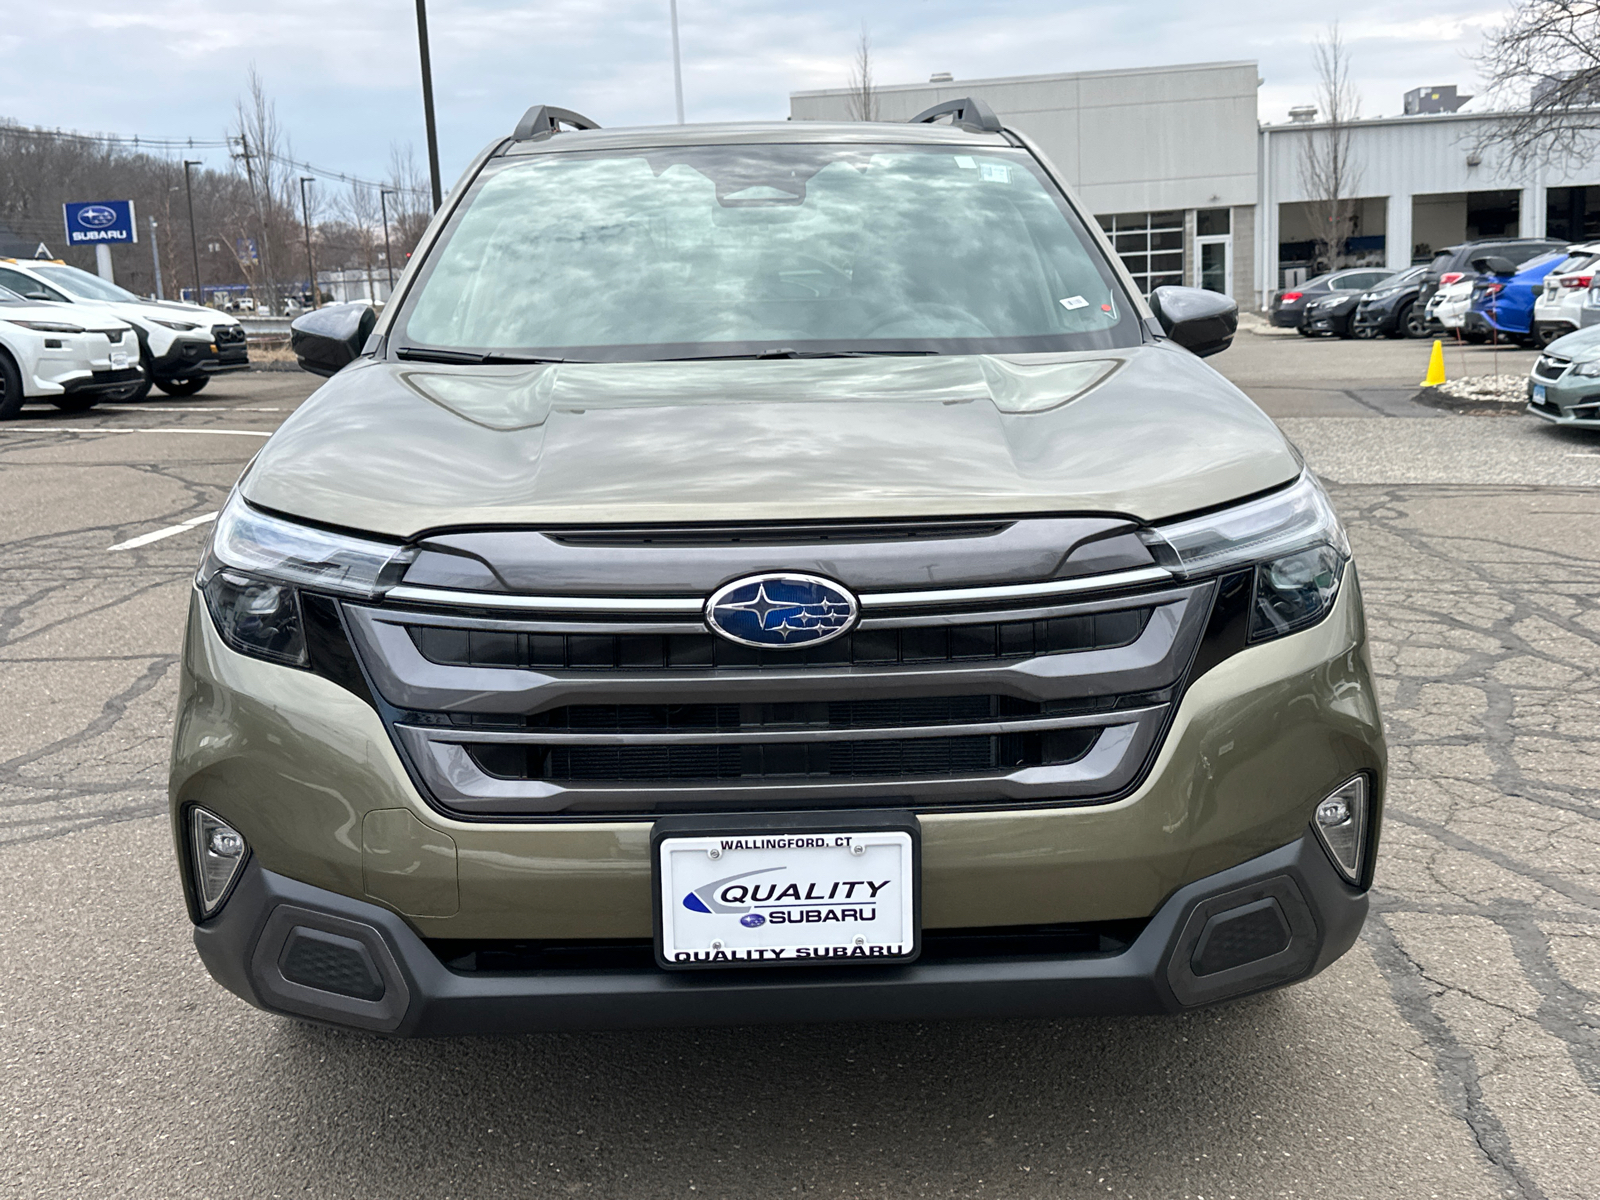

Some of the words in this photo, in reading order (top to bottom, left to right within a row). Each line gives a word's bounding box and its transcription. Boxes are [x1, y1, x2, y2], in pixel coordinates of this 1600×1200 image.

[72, 230, 127, 241] SUBARU
[720, 838, 829, 850] WALLINGFORD,
[835, 837, 852, 847] CT
[720, 880, 891, 904] QUALITY
[768, 908, 876, 924] SUBARU
[674, 949, 786, 962] QUALITY
[795, 945, 903, 958] SUBARU
